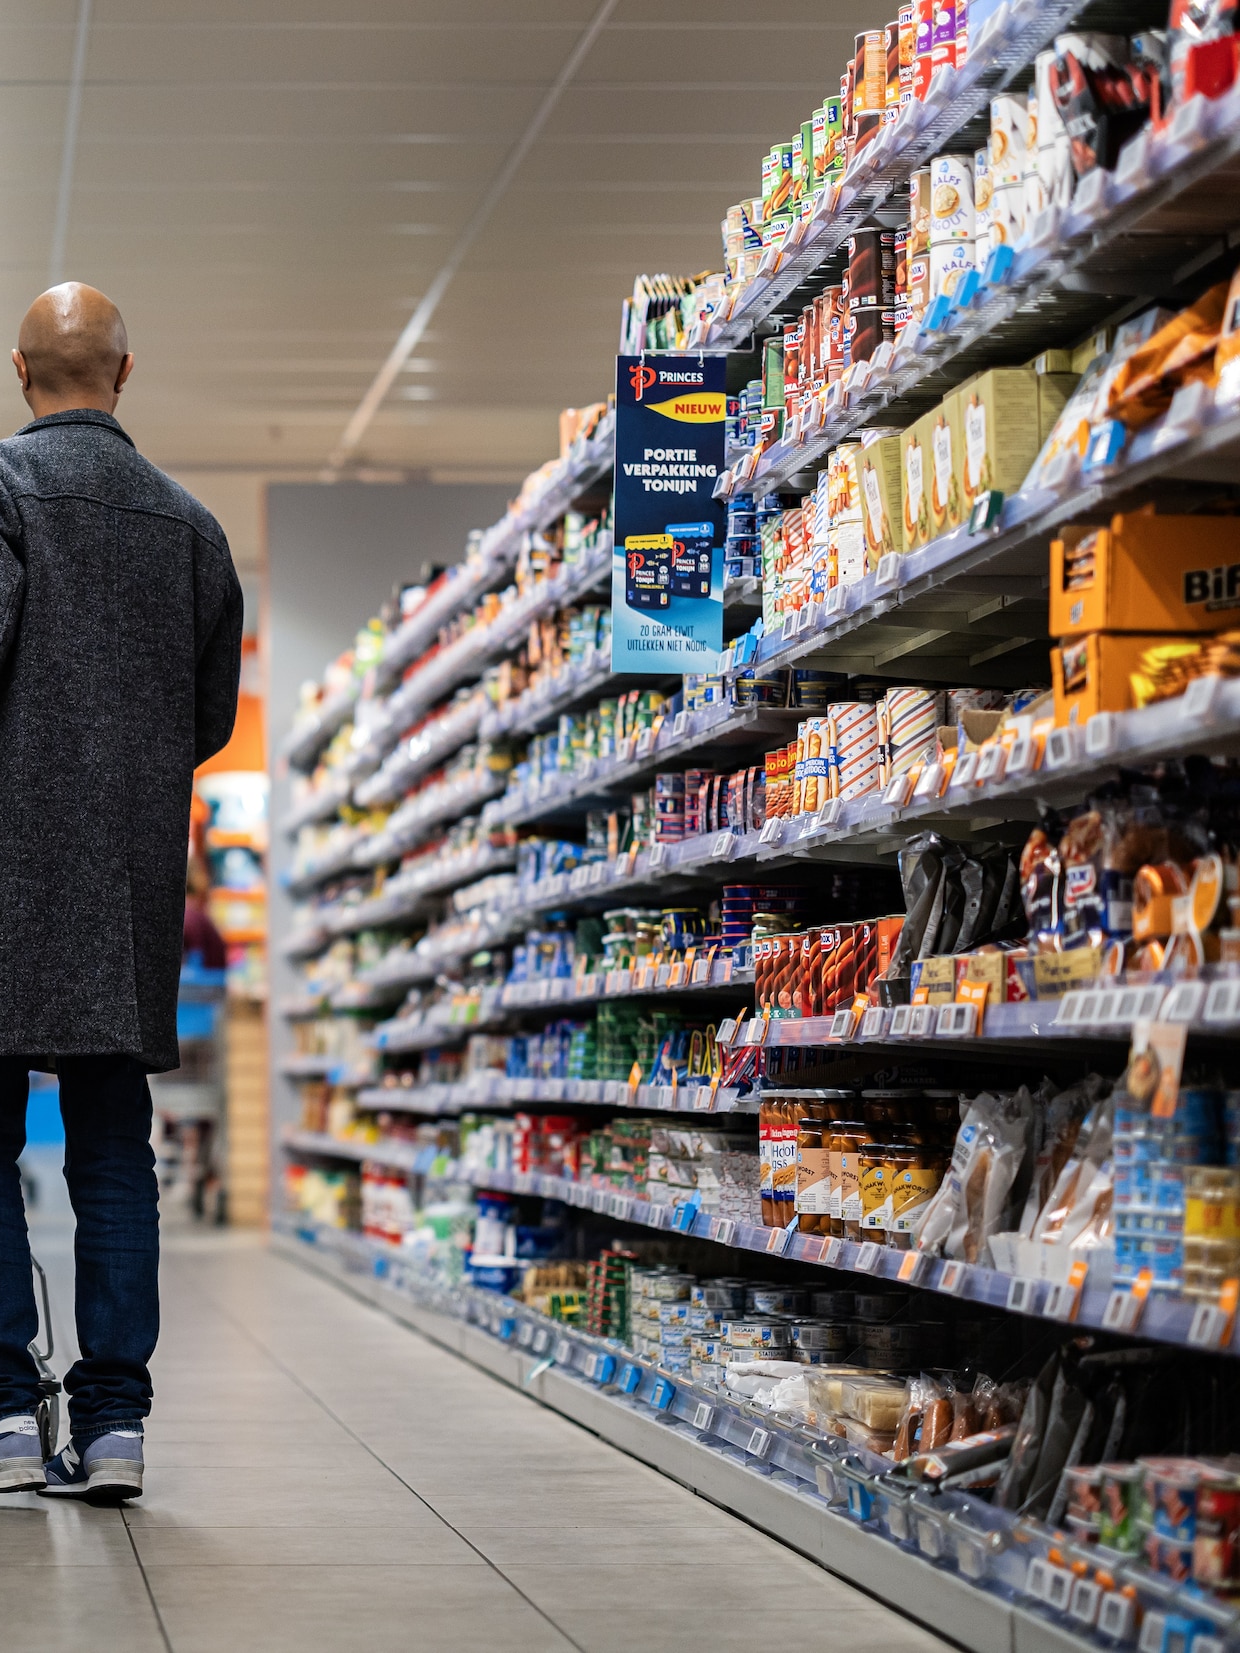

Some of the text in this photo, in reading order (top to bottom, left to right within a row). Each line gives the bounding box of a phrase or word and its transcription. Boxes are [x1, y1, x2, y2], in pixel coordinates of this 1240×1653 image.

[659, 371, 704, 383] PRINCES
[675, 404, 721, 415] NIEUW
[644, 449, 697, 461] PORTIE
[623, 464, 717, 477] VERPAKKING
[643, 479, 697, 495] TONIJN
[640, 625, 694, 637] 20 GRAM EIWIT
[627, 640, 707, 652] UITLEKKEN NIET NODIG
